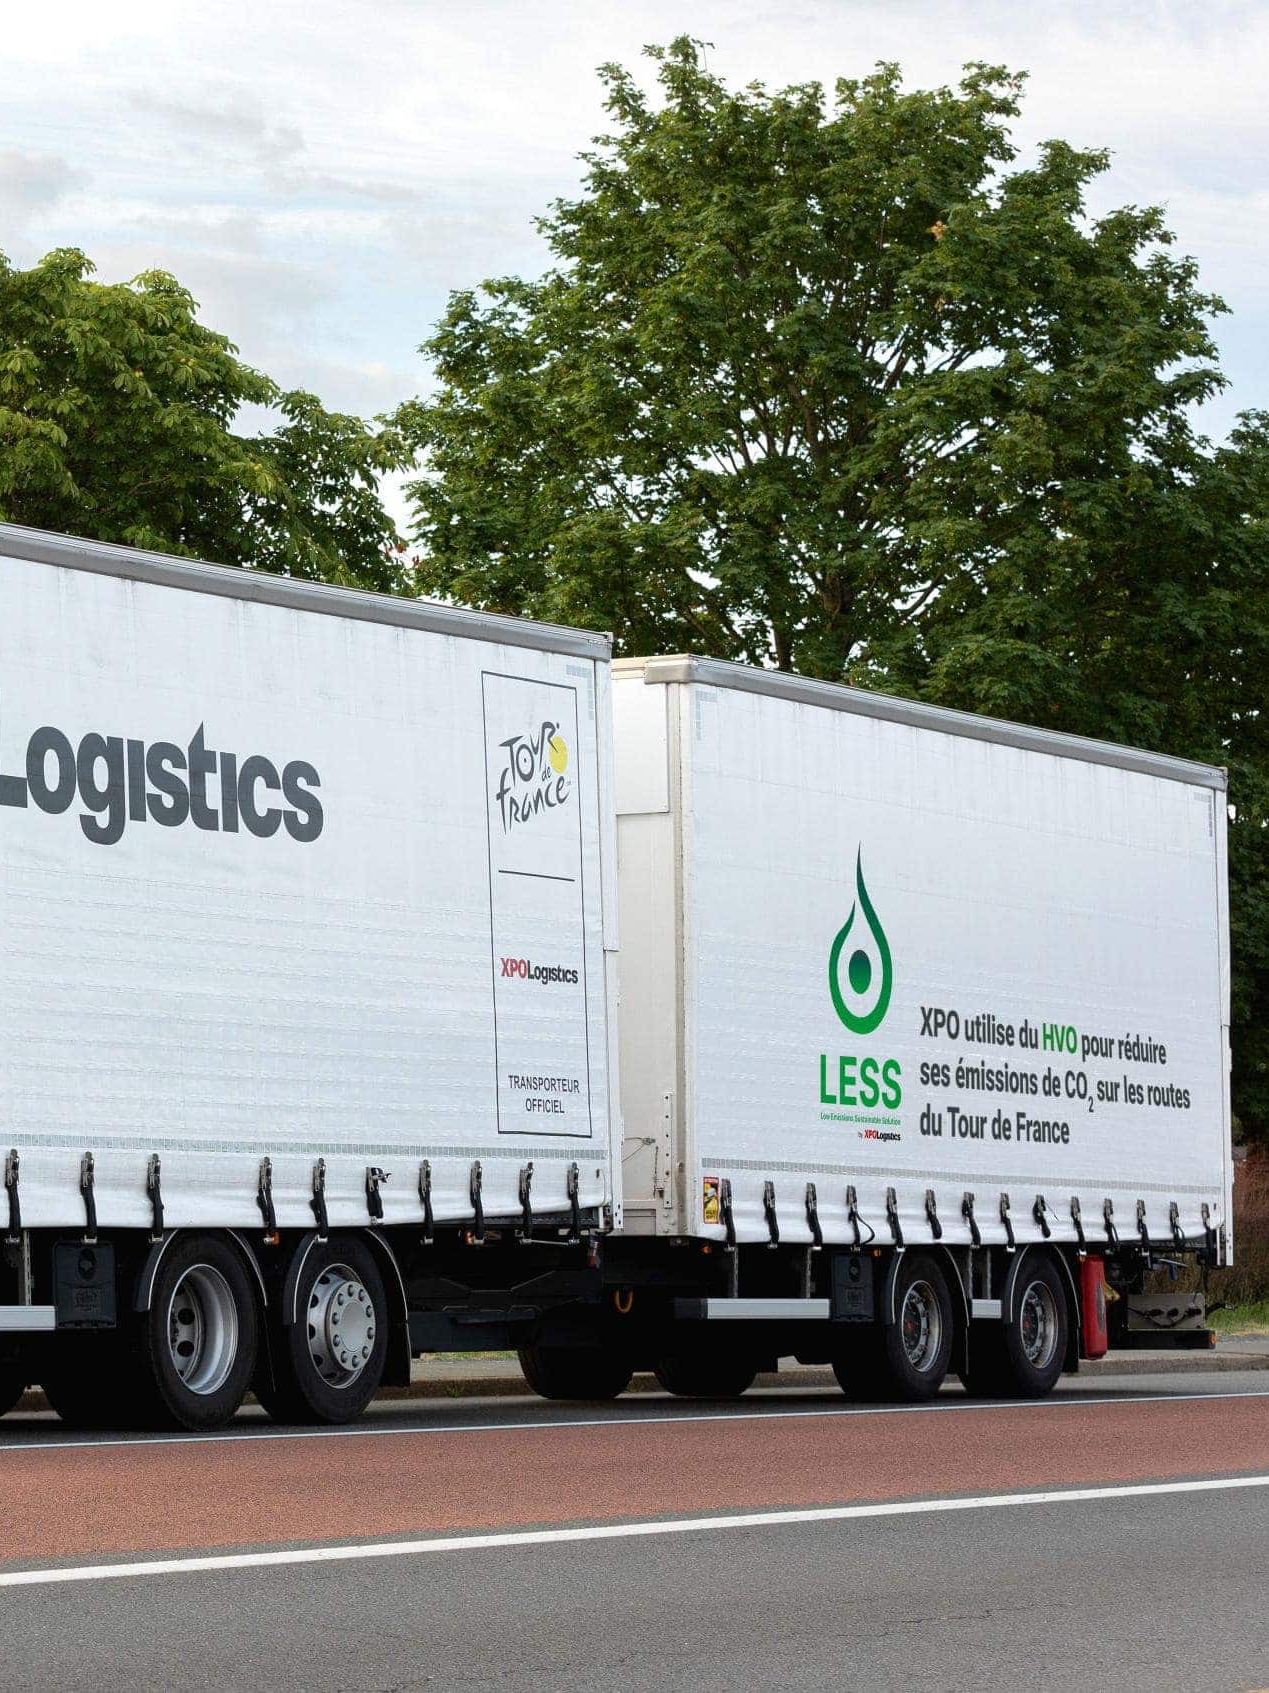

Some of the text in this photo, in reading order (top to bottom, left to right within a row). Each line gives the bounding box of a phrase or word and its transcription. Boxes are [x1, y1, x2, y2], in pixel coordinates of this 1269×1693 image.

[920, 1006, 1167, 1065] XPO utilise du HVO pour réduire
[508, 1074, 580, 1094] TRANSPORTEUR
[525, 1097, 565, 1114] OFFICIEL
[820, 1054, 902, 1110] LESS
[920, 1060, 951, 1088] ses
[955, 1057, 1038, 1095] émissions
[1042, 1066, 1061, 1098] de
[1097, 1078, 1120, 1102] sur
[1123, 1075, 1144, 1105] les
[1147, 1083, 1191, 1110] routes
[920, 1103, 1070, 1145] du Tour de France
